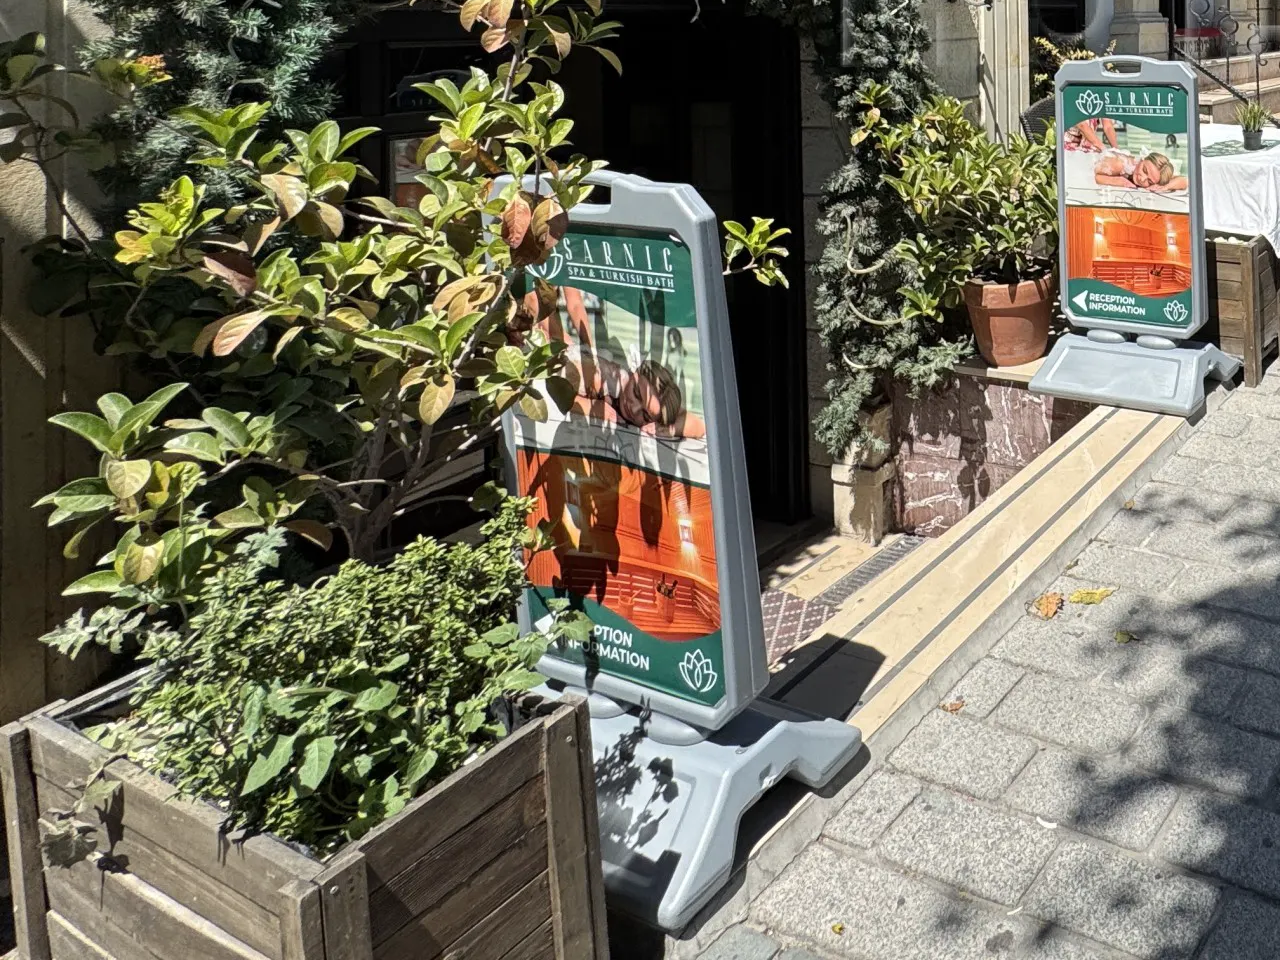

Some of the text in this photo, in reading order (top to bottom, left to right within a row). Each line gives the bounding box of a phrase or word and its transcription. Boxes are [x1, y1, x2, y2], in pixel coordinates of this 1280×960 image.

[1104, 91, 1174, 106] SARNIC
[563, 237, 673, 273] SARNIC
[568, 266, 675, 289] SPA & TURKISH BATH
[1089, 293, 1136, 305] RECEPTION
[1089, 302, 1146, 316] INFORMATION
[593, 624, 633, 648] PTION
[560, 635, 650, 671] INFORMATION
